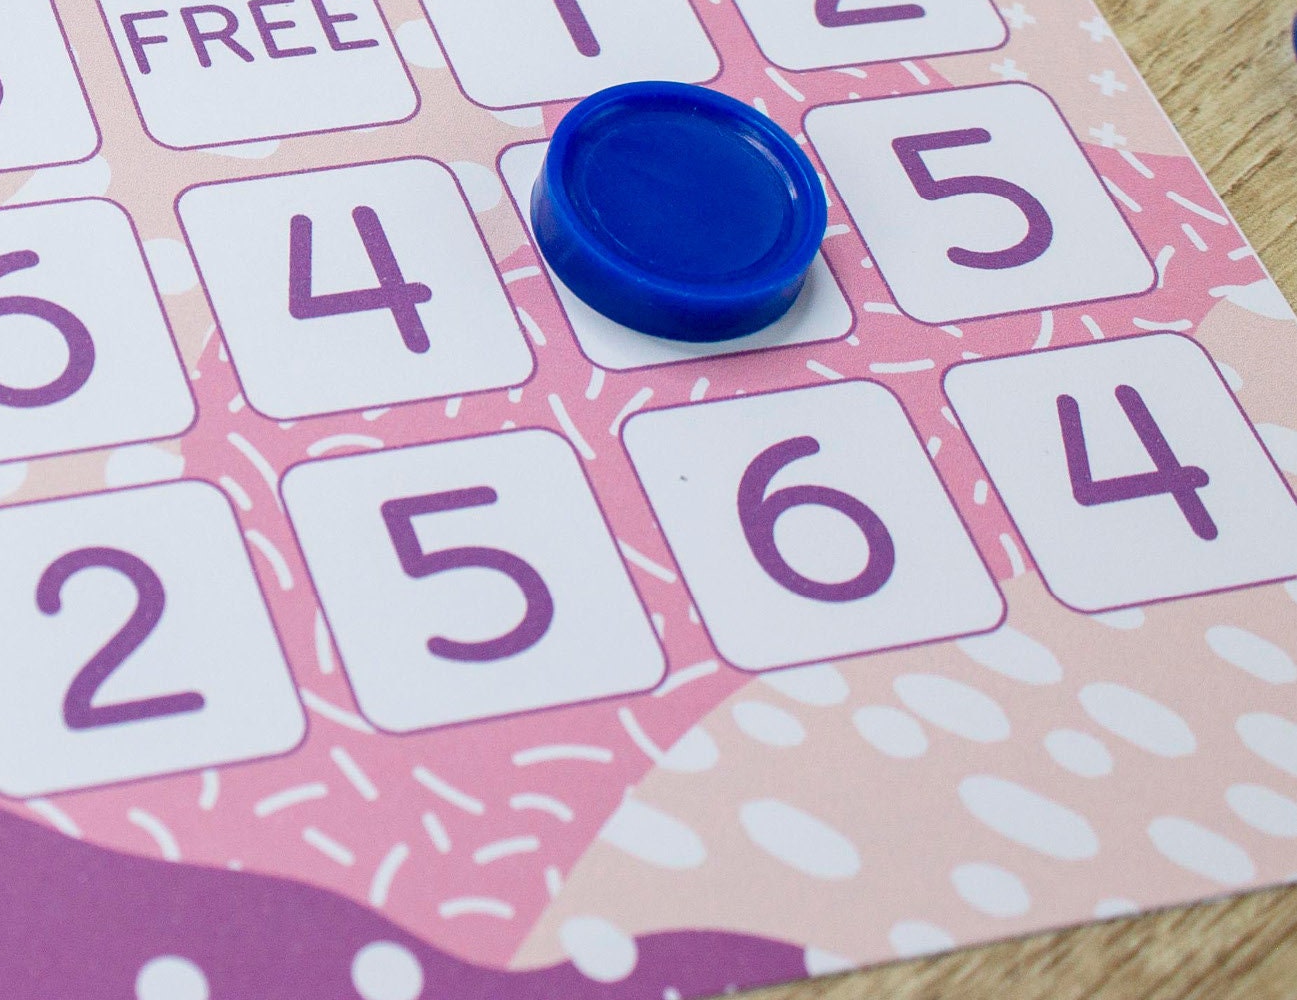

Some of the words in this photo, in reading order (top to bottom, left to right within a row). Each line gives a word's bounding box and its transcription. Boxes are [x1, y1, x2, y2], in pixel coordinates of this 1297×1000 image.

[289, 206, 432, 353] 4
[891, 128, 1053, 270] 5
[35, 547, 206, 730] 2
[381, 486, 554, 662] 5
[738, 436, 895, 602] 6
[1056, 385, 1218, 540] 4
